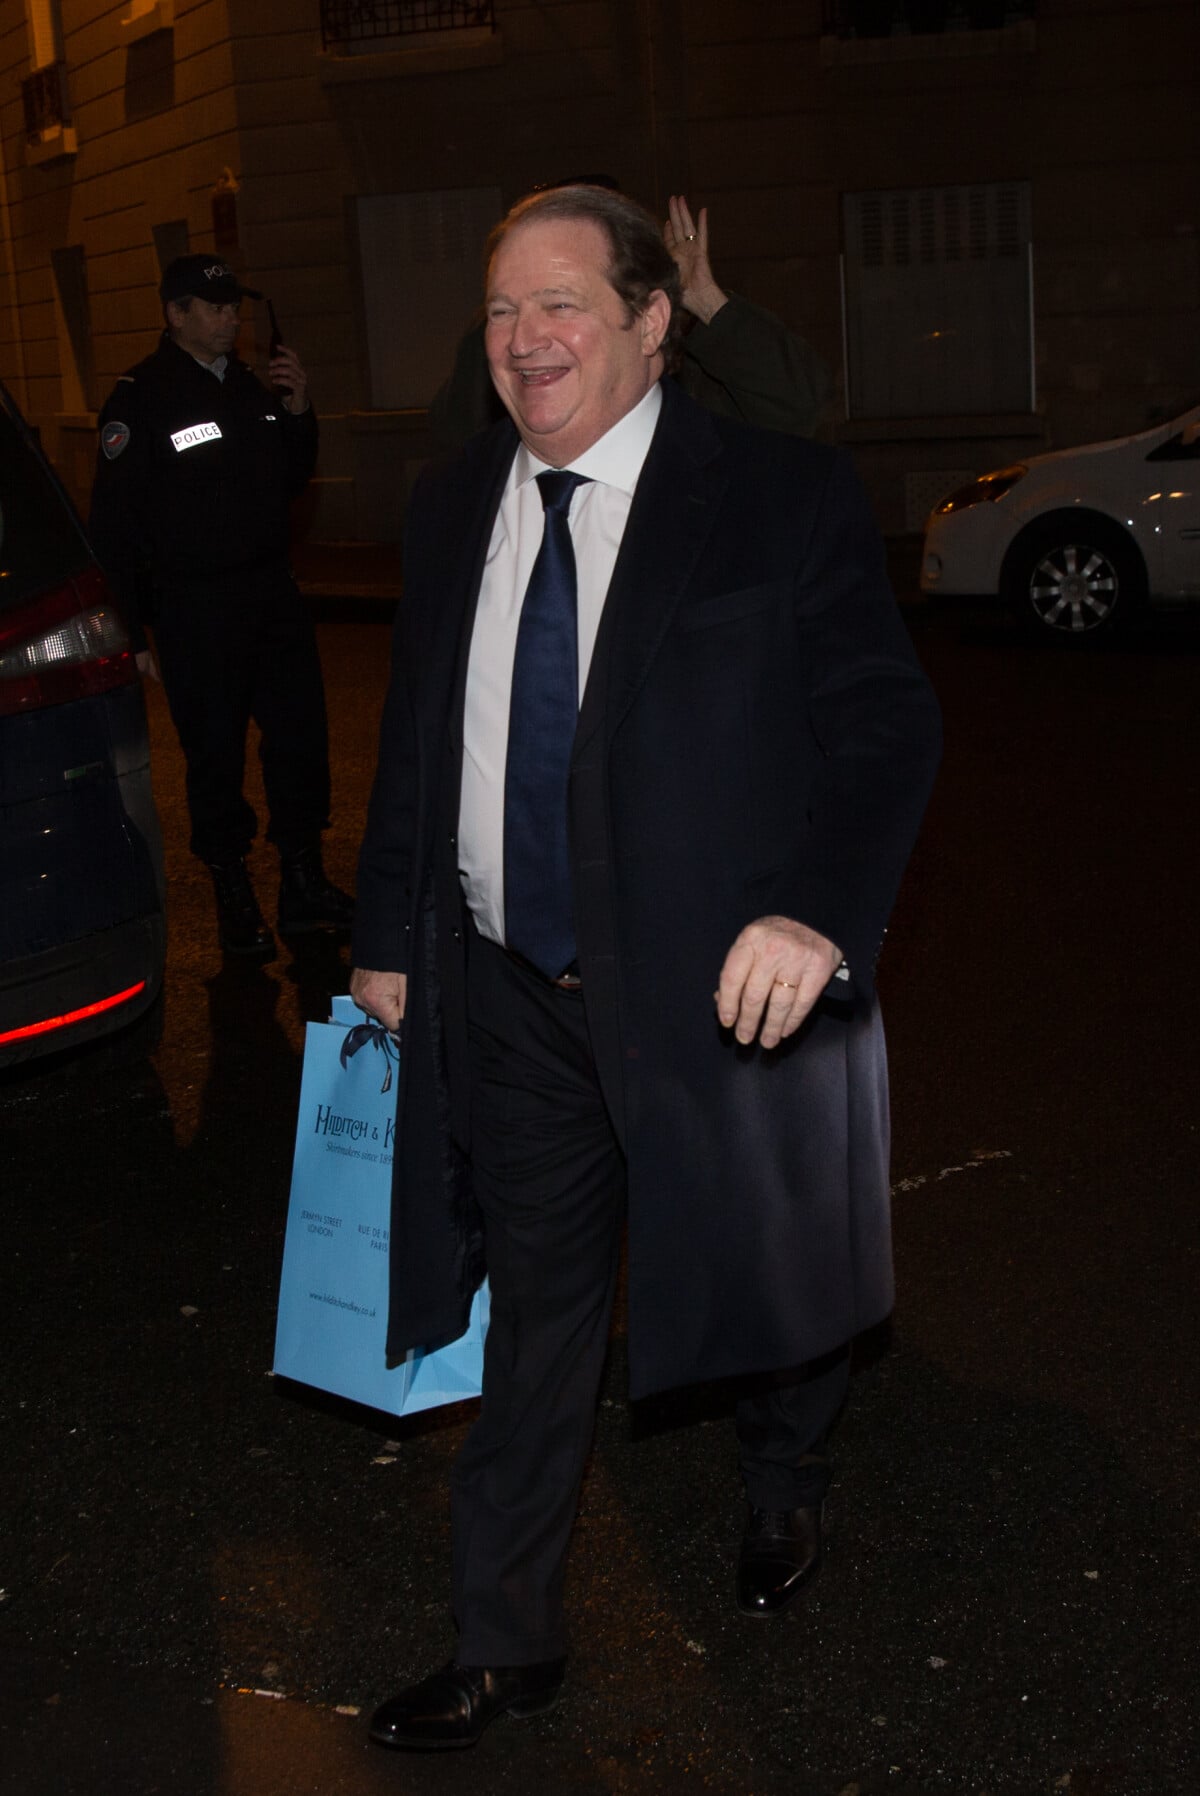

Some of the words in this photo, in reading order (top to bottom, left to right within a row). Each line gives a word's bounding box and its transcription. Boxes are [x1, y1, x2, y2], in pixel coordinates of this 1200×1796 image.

[174, 425, 220, 446] POLICE
[372, 1127, 379, 1141] &
[326, 1142, 361, 1158] Shirtmakers
[361, 1149, 379, 1163] since
[379, 1152, 394, 1165] 189
[323, 1216, 343, 1228] STREET
[307, 1224, 334, 1237] LONDON
[358, 1223, 370, 1235] RUE
[372, 1227, 380, 1238] DE
[370, 1240, 388, 1252] PARIS
